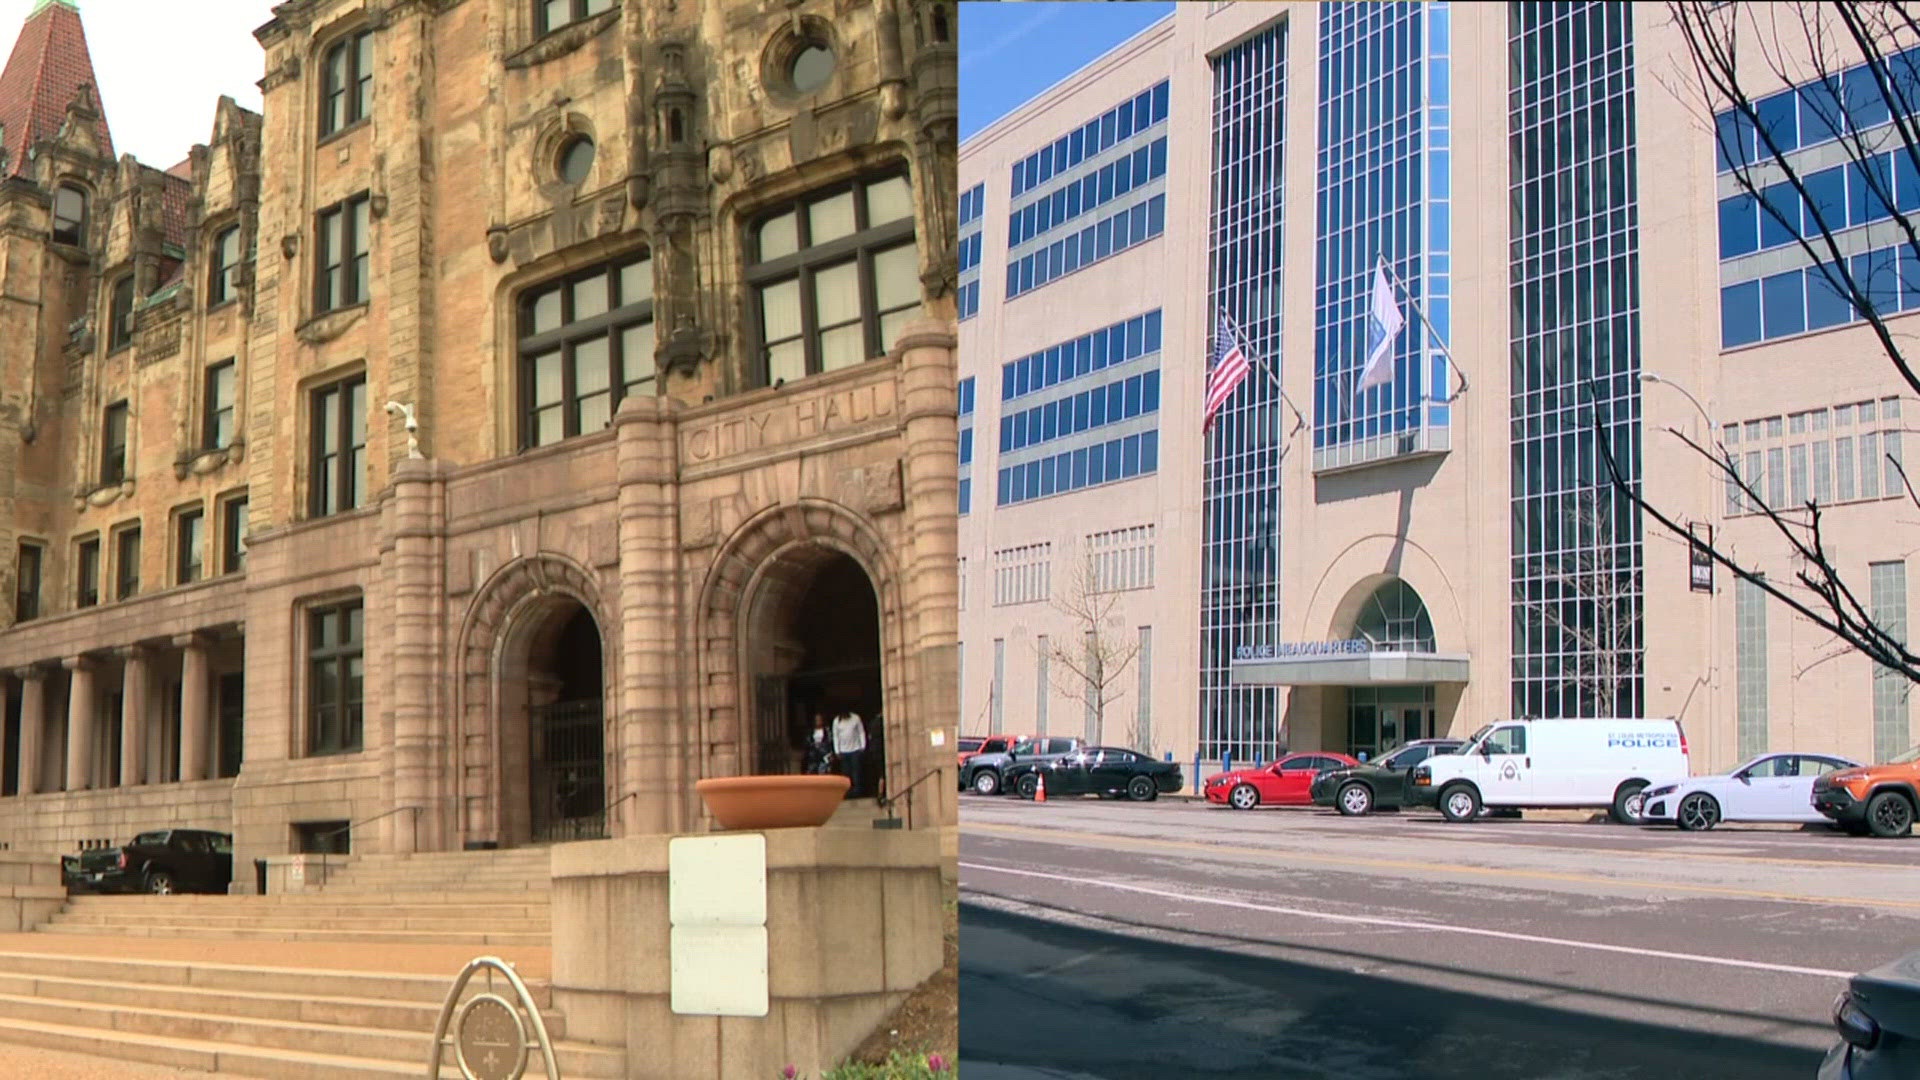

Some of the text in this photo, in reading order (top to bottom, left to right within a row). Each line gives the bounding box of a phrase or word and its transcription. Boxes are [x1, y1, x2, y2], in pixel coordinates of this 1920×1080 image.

[689, 386, 892, 460] CITY HALL
[1236, 638, 1368, 659] POLICE HEADQUARTERS
[1608, 739, 1679, 748] POLICE
